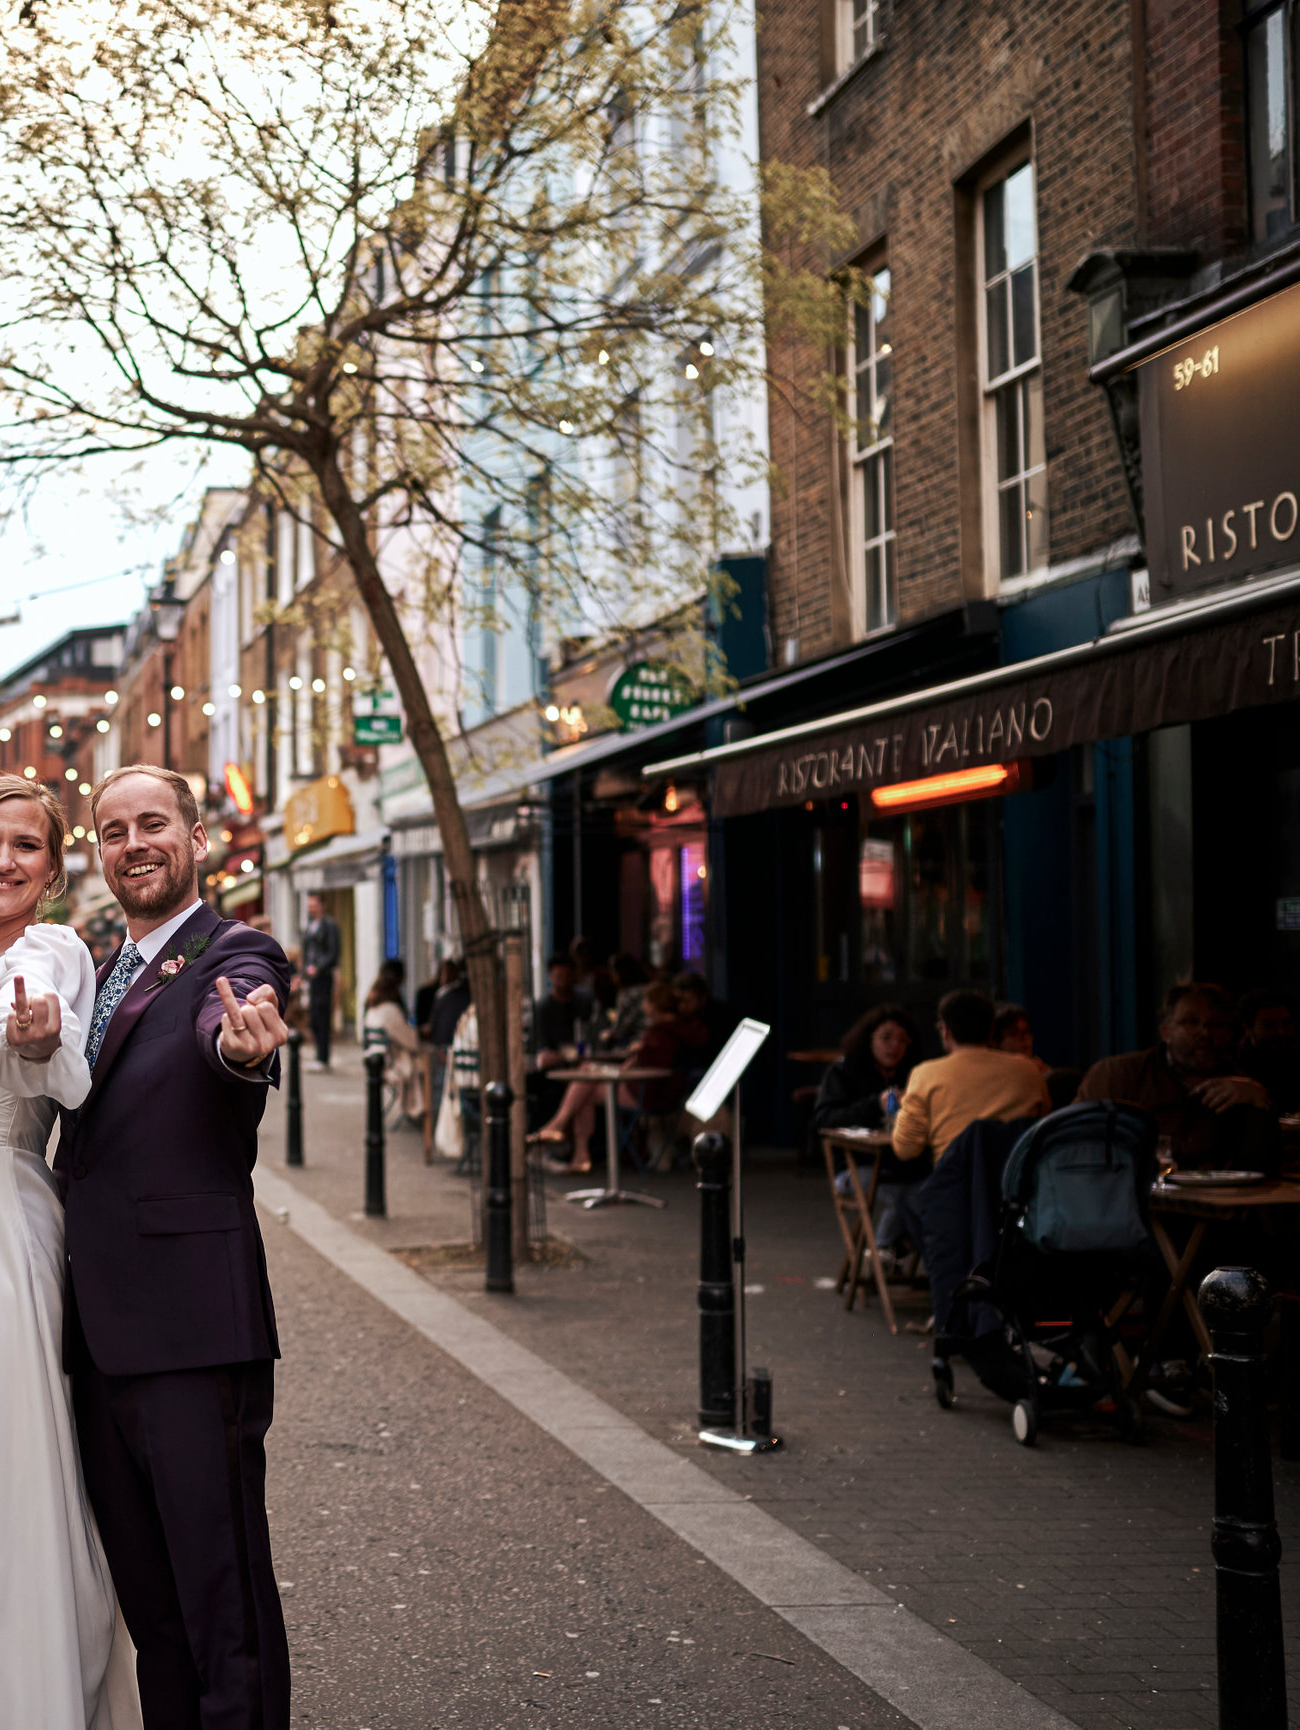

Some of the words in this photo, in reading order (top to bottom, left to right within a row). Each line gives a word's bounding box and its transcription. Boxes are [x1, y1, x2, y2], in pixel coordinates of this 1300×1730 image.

[1173, 345, 1220, 391] 59-61
[1180, 491, 1299, 572] RISTO
[777, 734, 903, 797] RISTORANTE
[922, 697, 1053, 767] ITALIANO
